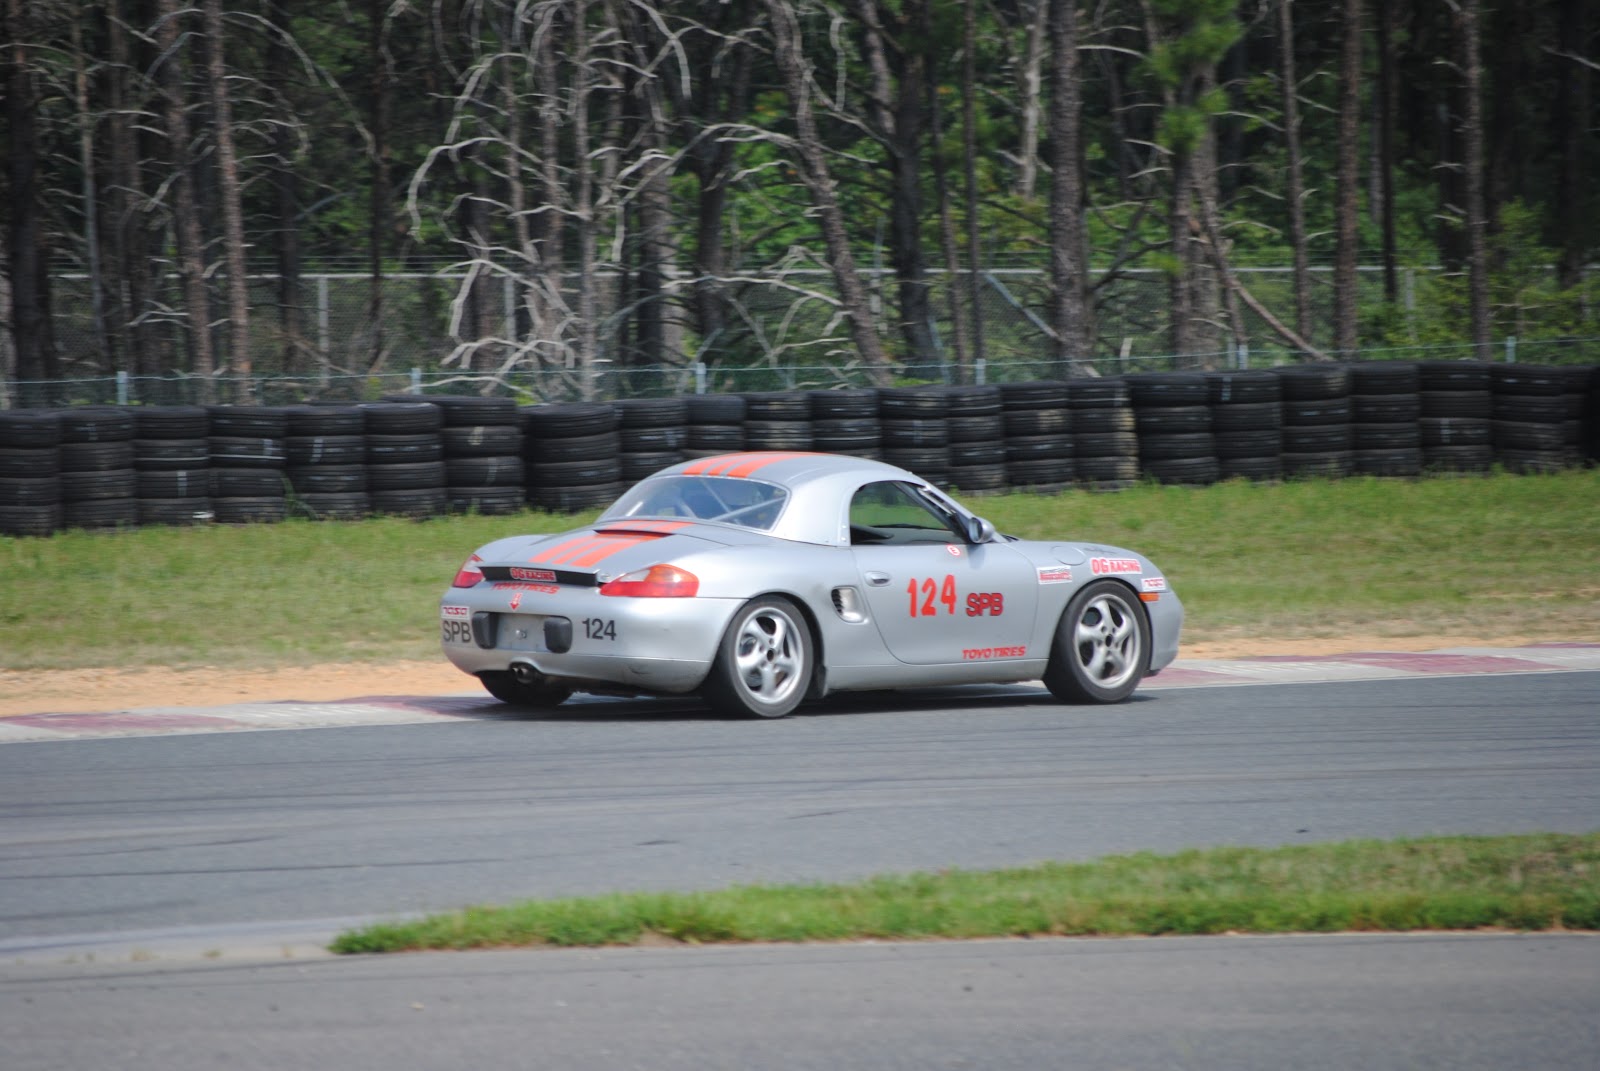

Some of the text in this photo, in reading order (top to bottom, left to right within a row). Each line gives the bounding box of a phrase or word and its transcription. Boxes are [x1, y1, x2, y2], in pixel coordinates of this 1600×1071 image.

[1091, 559, 1109, 574] OG
[907, 574, 957, 618] 124
[966, 592, 1004, 617] SPB
[443, 620, 472, 643] SPB
[582, 618, 617, 641] 124
[962, 646, 1026, 660] TOYO TIRES
